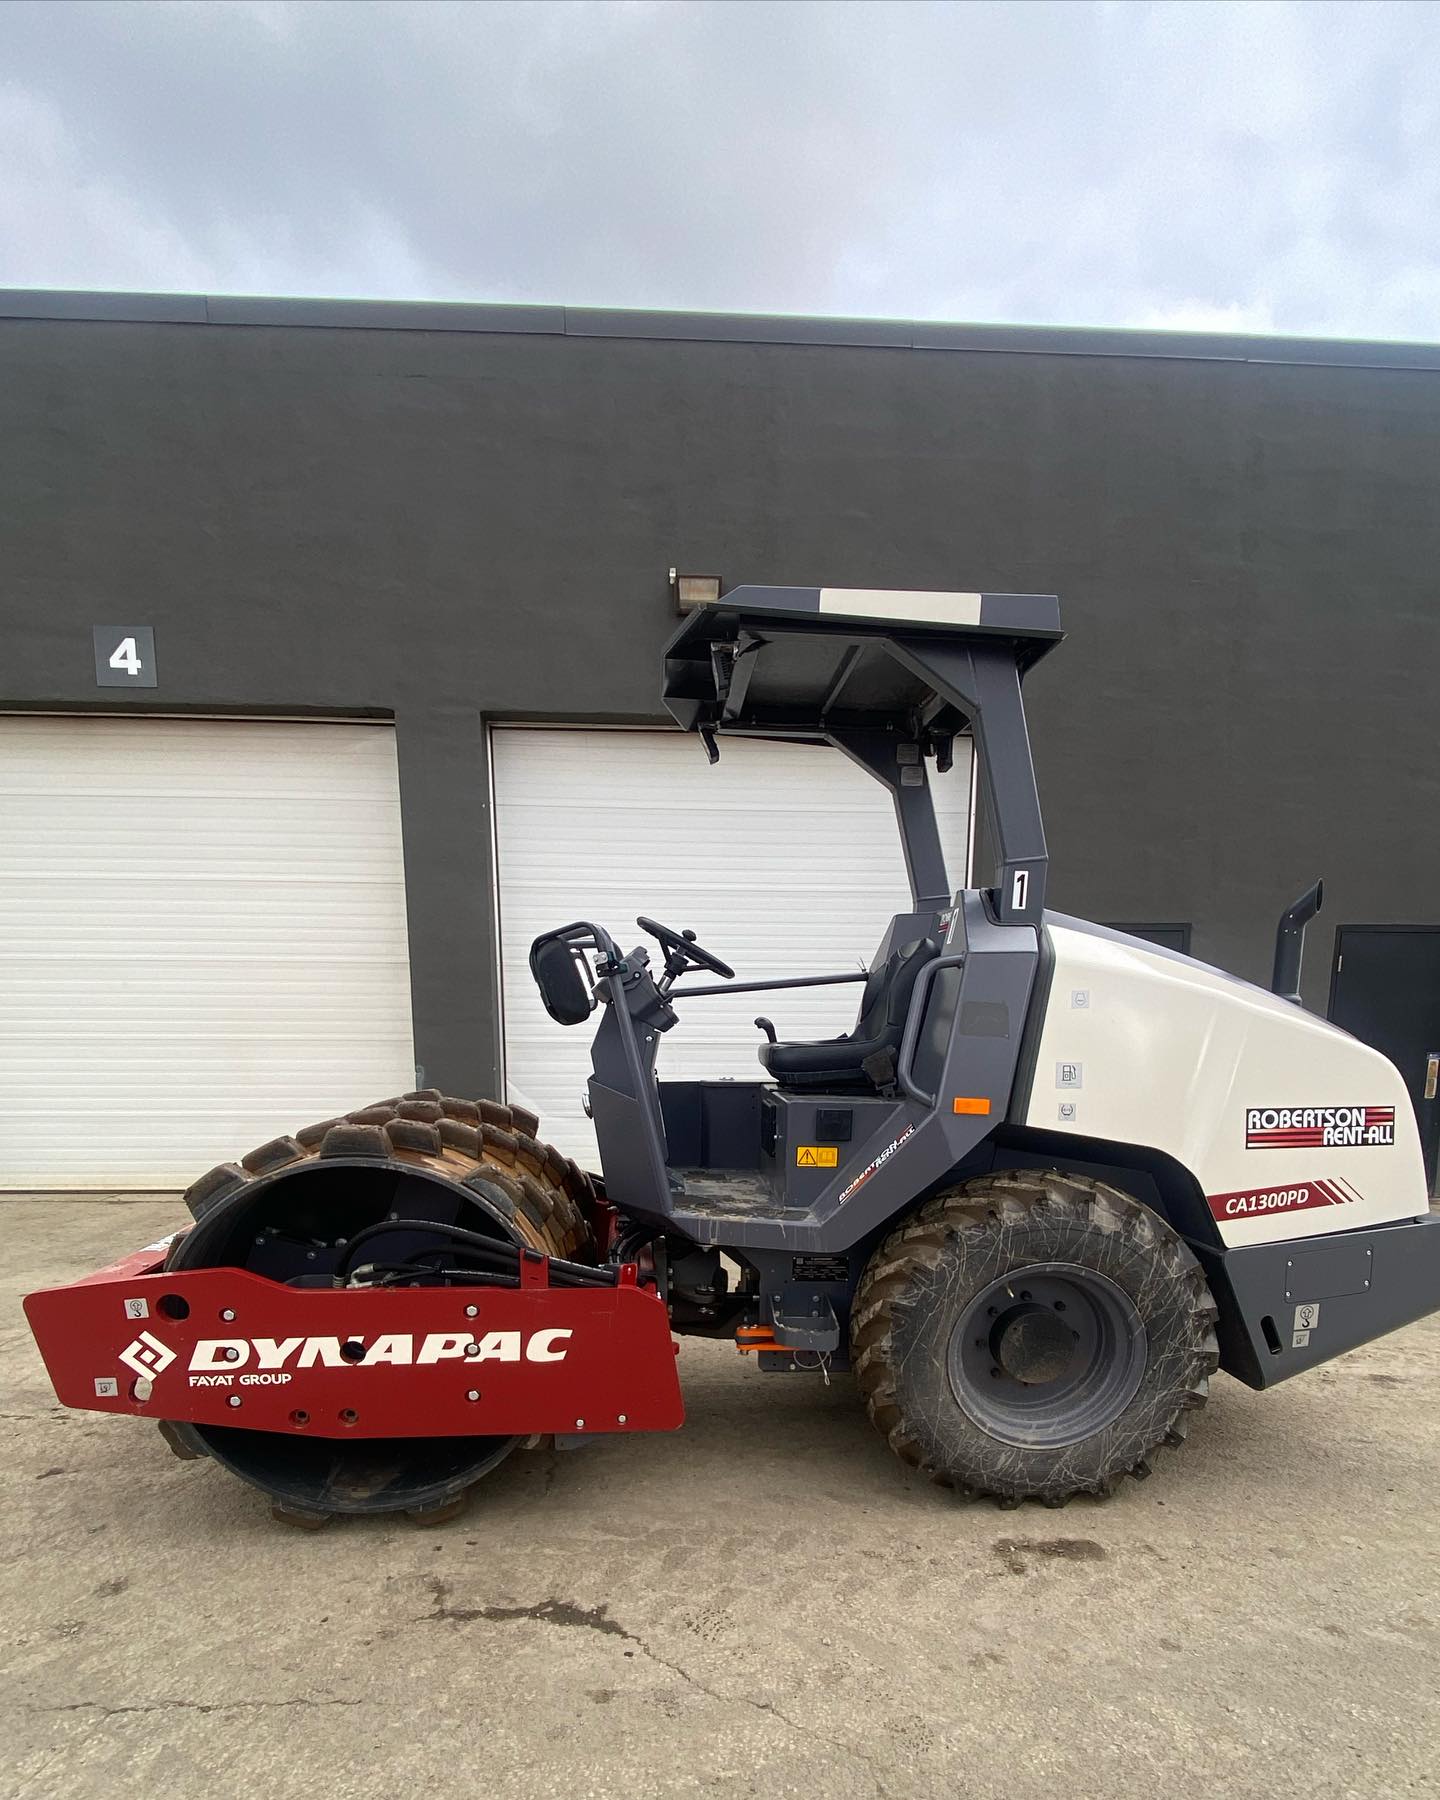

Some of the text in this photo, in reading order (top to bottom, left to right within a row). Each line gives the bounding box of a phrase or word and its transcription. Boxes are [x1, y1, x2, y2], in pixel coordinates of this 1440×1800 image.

[109, 637, 142, 675] 4
[1016, 873, 1026, 908] 1
[1247, 1108, 1366, 1129] ROBERTSON
[1323, 1125, 1393, 1146] RENT-ALL
[1225, 1188, 1309, 1214] CA1300PD
[187, 1328, 573, 1372] DYNAPAC
[188, 1373, 292, 1387] FAYAT GROUP
